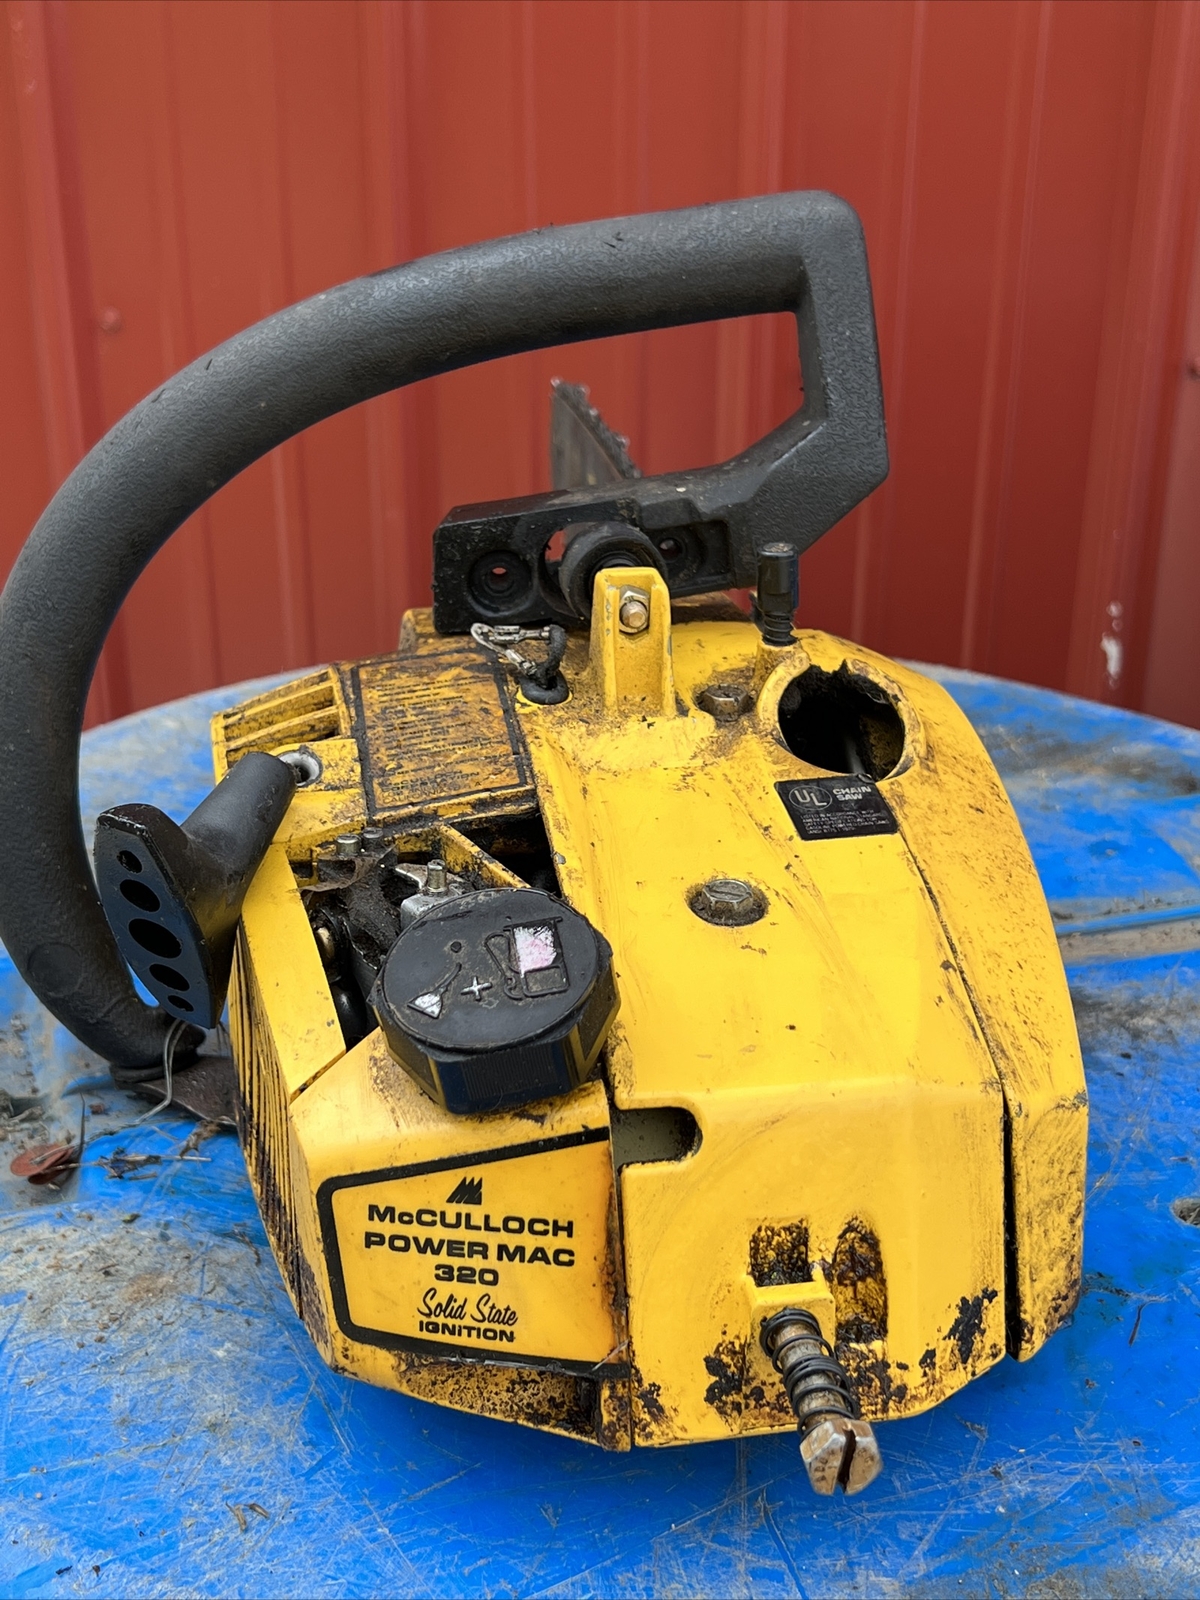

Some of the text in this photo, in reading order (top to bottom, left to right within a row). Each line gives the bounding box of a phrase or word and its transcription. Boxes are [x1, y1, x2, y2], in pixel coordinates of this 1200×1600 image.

[794, 789, 828, 806] UL
[833, 786, 872, 795] CHAIN
[836, 793, 863, 801] SAW
[368, 1204, 574, 1238] McCULLOCH
[364, 1231, 575, 1267] POWER MAC
[434, 1263, 499, 1286] 320
[416, 1287, 518, 1326] Solid State
[419, 1320, 515, 1343] IGNITION
